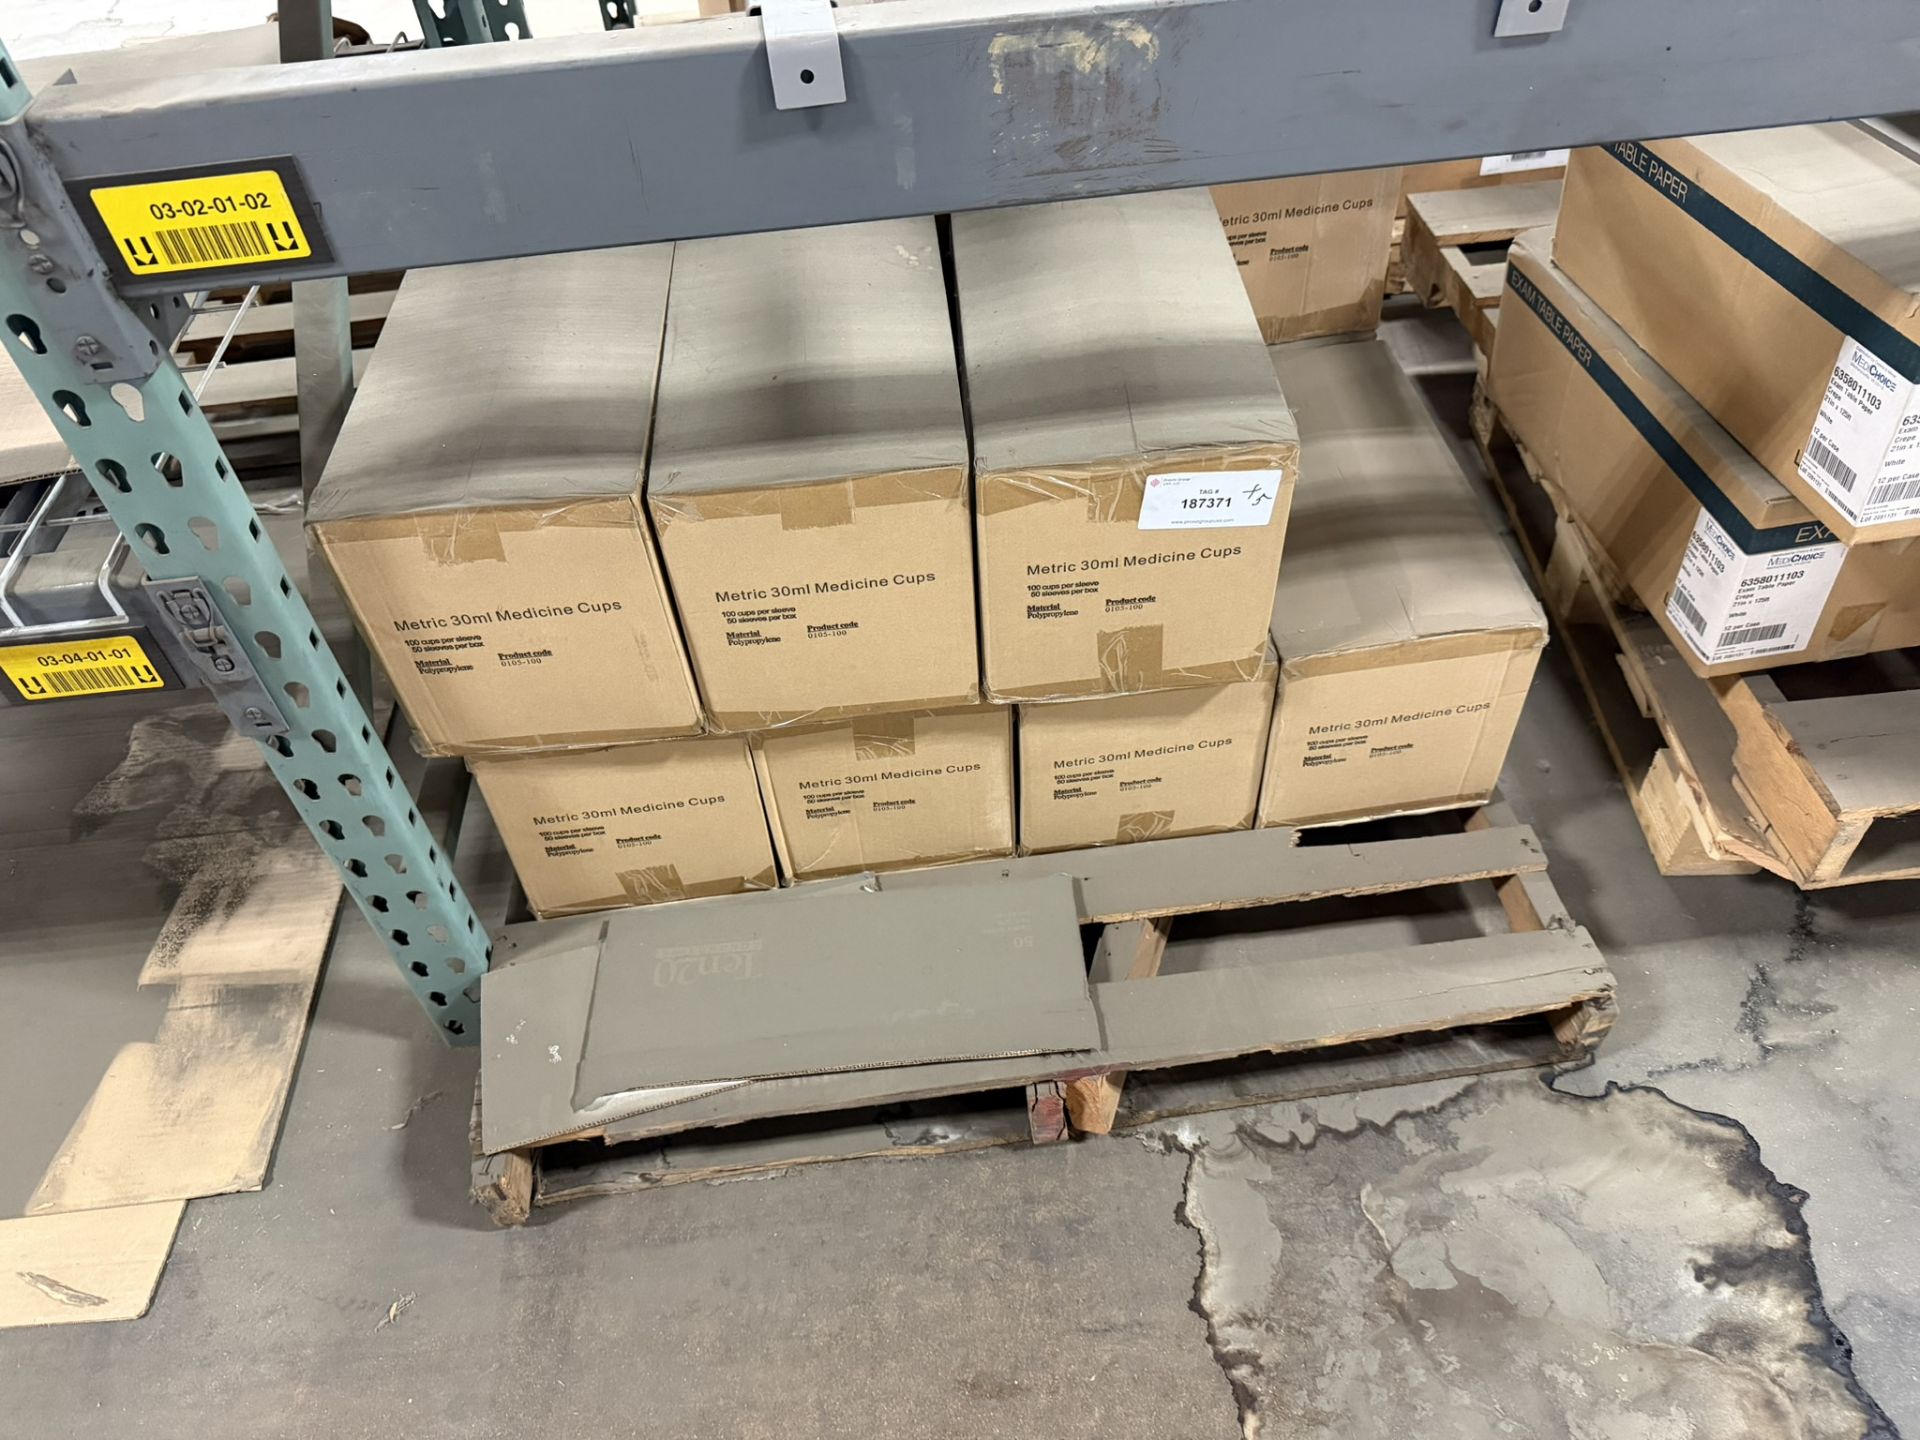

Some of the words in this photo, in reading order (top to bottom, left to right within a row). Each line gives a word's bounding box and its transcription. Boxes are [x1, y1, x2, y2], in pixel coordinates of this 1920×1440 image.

[1649, 160, 1689, 203] PAPER
[150, 192, 271, 221] 03-02-01-02
[1220, 214, 1249, 227] etric
[1252, 209, 1281, 223] 30ml
[1285, 204, 1339, 218] Medicine
[1342, 198, 1373, 211] Cups
[1511, 271, 1537, 301] EXAM
[1537, 295, 1563, 334] TABLE
[1563, 325, 1592, 367] PAPER
[1827, 386, 1842, 401] Crepe
[1834, 366, 1882, 410] 6358011103
[1824, 395, 1834, 407] 21in
[1831, 378, 1843, 391] Exam
[1844, 388, 1858, 404] Table
[1858, 398, 1873, 416] Paper
[1820, 411, 1833, 425] White
[1820, 434, 1829, 442] per
[1830, 438, 1840, 452] Case
[1895, 435, 1916, 443] Crepe
[1885, 459, 1905, 467] White
[1182, 497, 1232, 509] 187371
[1027, 562, 1076, 576] Metric
[1080, 557, 1118, 571] 30ml
[1123, 551, 1196, 568] Medicine
[1200, 545, 1242, 560] Cups
[1741, 570, 1804, 587] 6358011103
[715, 589, 767, 603] Metric
[771, 584, 811, 598] 30ml
[815, 577, 889, 594] Medicine
[893, 572, 936, 585] Cups
[1042, 583, 1060, 591] cups
[1042, 589, 1070, 597] sleeves
[1071, 588, 1084, 596] per
[1105, 597, 1136, 606] Product
[737, 610, 755, 618] cups
[1027, 603, 1060, 613] Material
[1027, 609, 1078, 619] Polypropylene
[1105, 604, 1143, 613] 0105-100
[393, 617, 447, 632] Metric
[451, 611, 493, 626] 30ml
[495, 605, 573, 622] Medicine
[577, 600, 622, 615] Cups
[738, 615, 767, 623] sleeves
[768, 614, 781, 622] per
[807, 624, 839, 633] Product
[841, 621, 859, 629] code
[421, 638, 440, 646] cups
[456, 634, 482, 642] sleeve
[726, 630, 761, 639] Material
[728, 636, 781, 645] Polypropylene
[808, 630, 847, 639] 0105-100
[424, 644, 454, 652] sleeves
[469, 641, 485, 649] box
[37, 648, 132, 667] 03-04-01-01
[498, 651, 531, 660] Product
[532, 649, 553, 657] code
[414, 658, 452, 668] Material
[418, 664, 474, 674] Polypropylene
[1309, 723, 1352, 735] Metric
[1354, 717, 1388, 729] 30ml
[1390, 708, 1452, 724] Medicine
[1456, 701, 1491, 714] Cups
[1054, 758, 1095, 769] Metric
[1098, 751, 1131, 764] 30ml
[1135, 744, 1194, 759] Medicine
[1198, 738, 1232, 749] Cups
[799, 779, 842, 790] Metric
[845, 774, 878, 785] 30ml
[881, 768, 942, 781] Medicine
[946, 763, 981, 774] Cups
[1054, 787, 1082, 795] Material
[533, 814, 579, 826] Metric
[582, 809, 617, 820] 30ml
[620, 800, 685, 816] Medicine
[688, 794, 726, 806] Cups
[806, 806, 835, 814] Material
[554, 833, 580, 841] sleeves
[545, 844, 576, 852] Material
